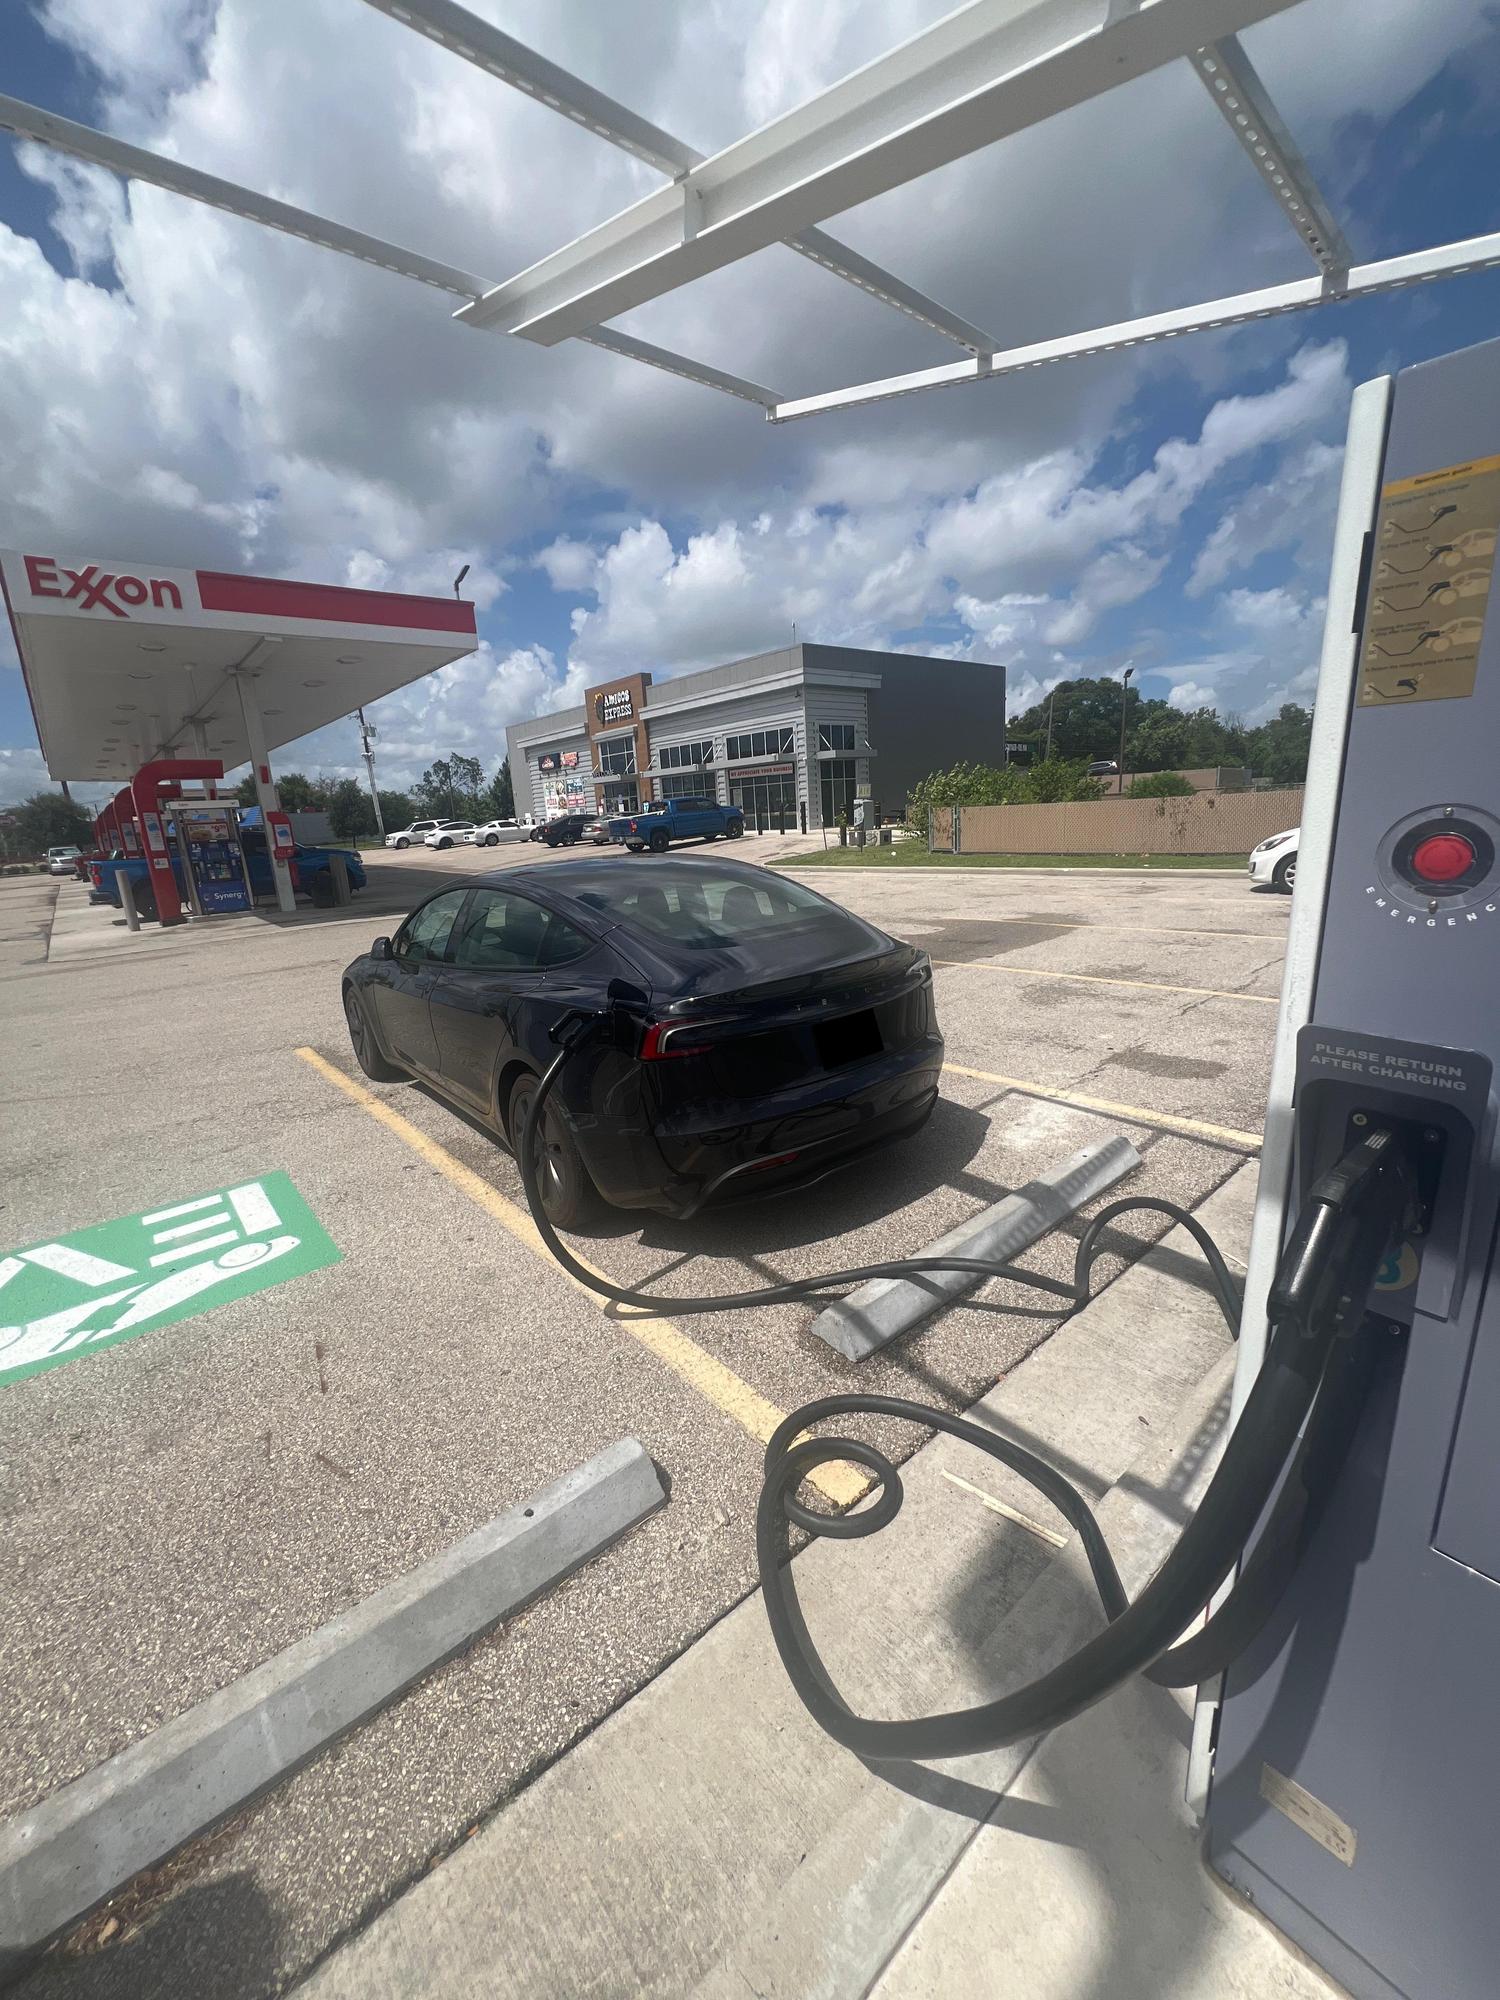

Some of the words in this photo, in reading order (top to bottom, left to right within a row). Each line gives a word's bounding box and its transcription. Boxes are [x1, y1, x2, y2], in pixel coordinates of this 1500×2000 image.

[23, 555, 183, 618] Exxon
[604, 704, 632, 720] EXPRESS
[1310, 1054, 1364, 1072] AFTER
[1368, 1065, 1468, 1091] CHARGING
[1315, 1043, 1380, 1062] PLEASE
[1385, 1055, 1463, 1077] RETURN
